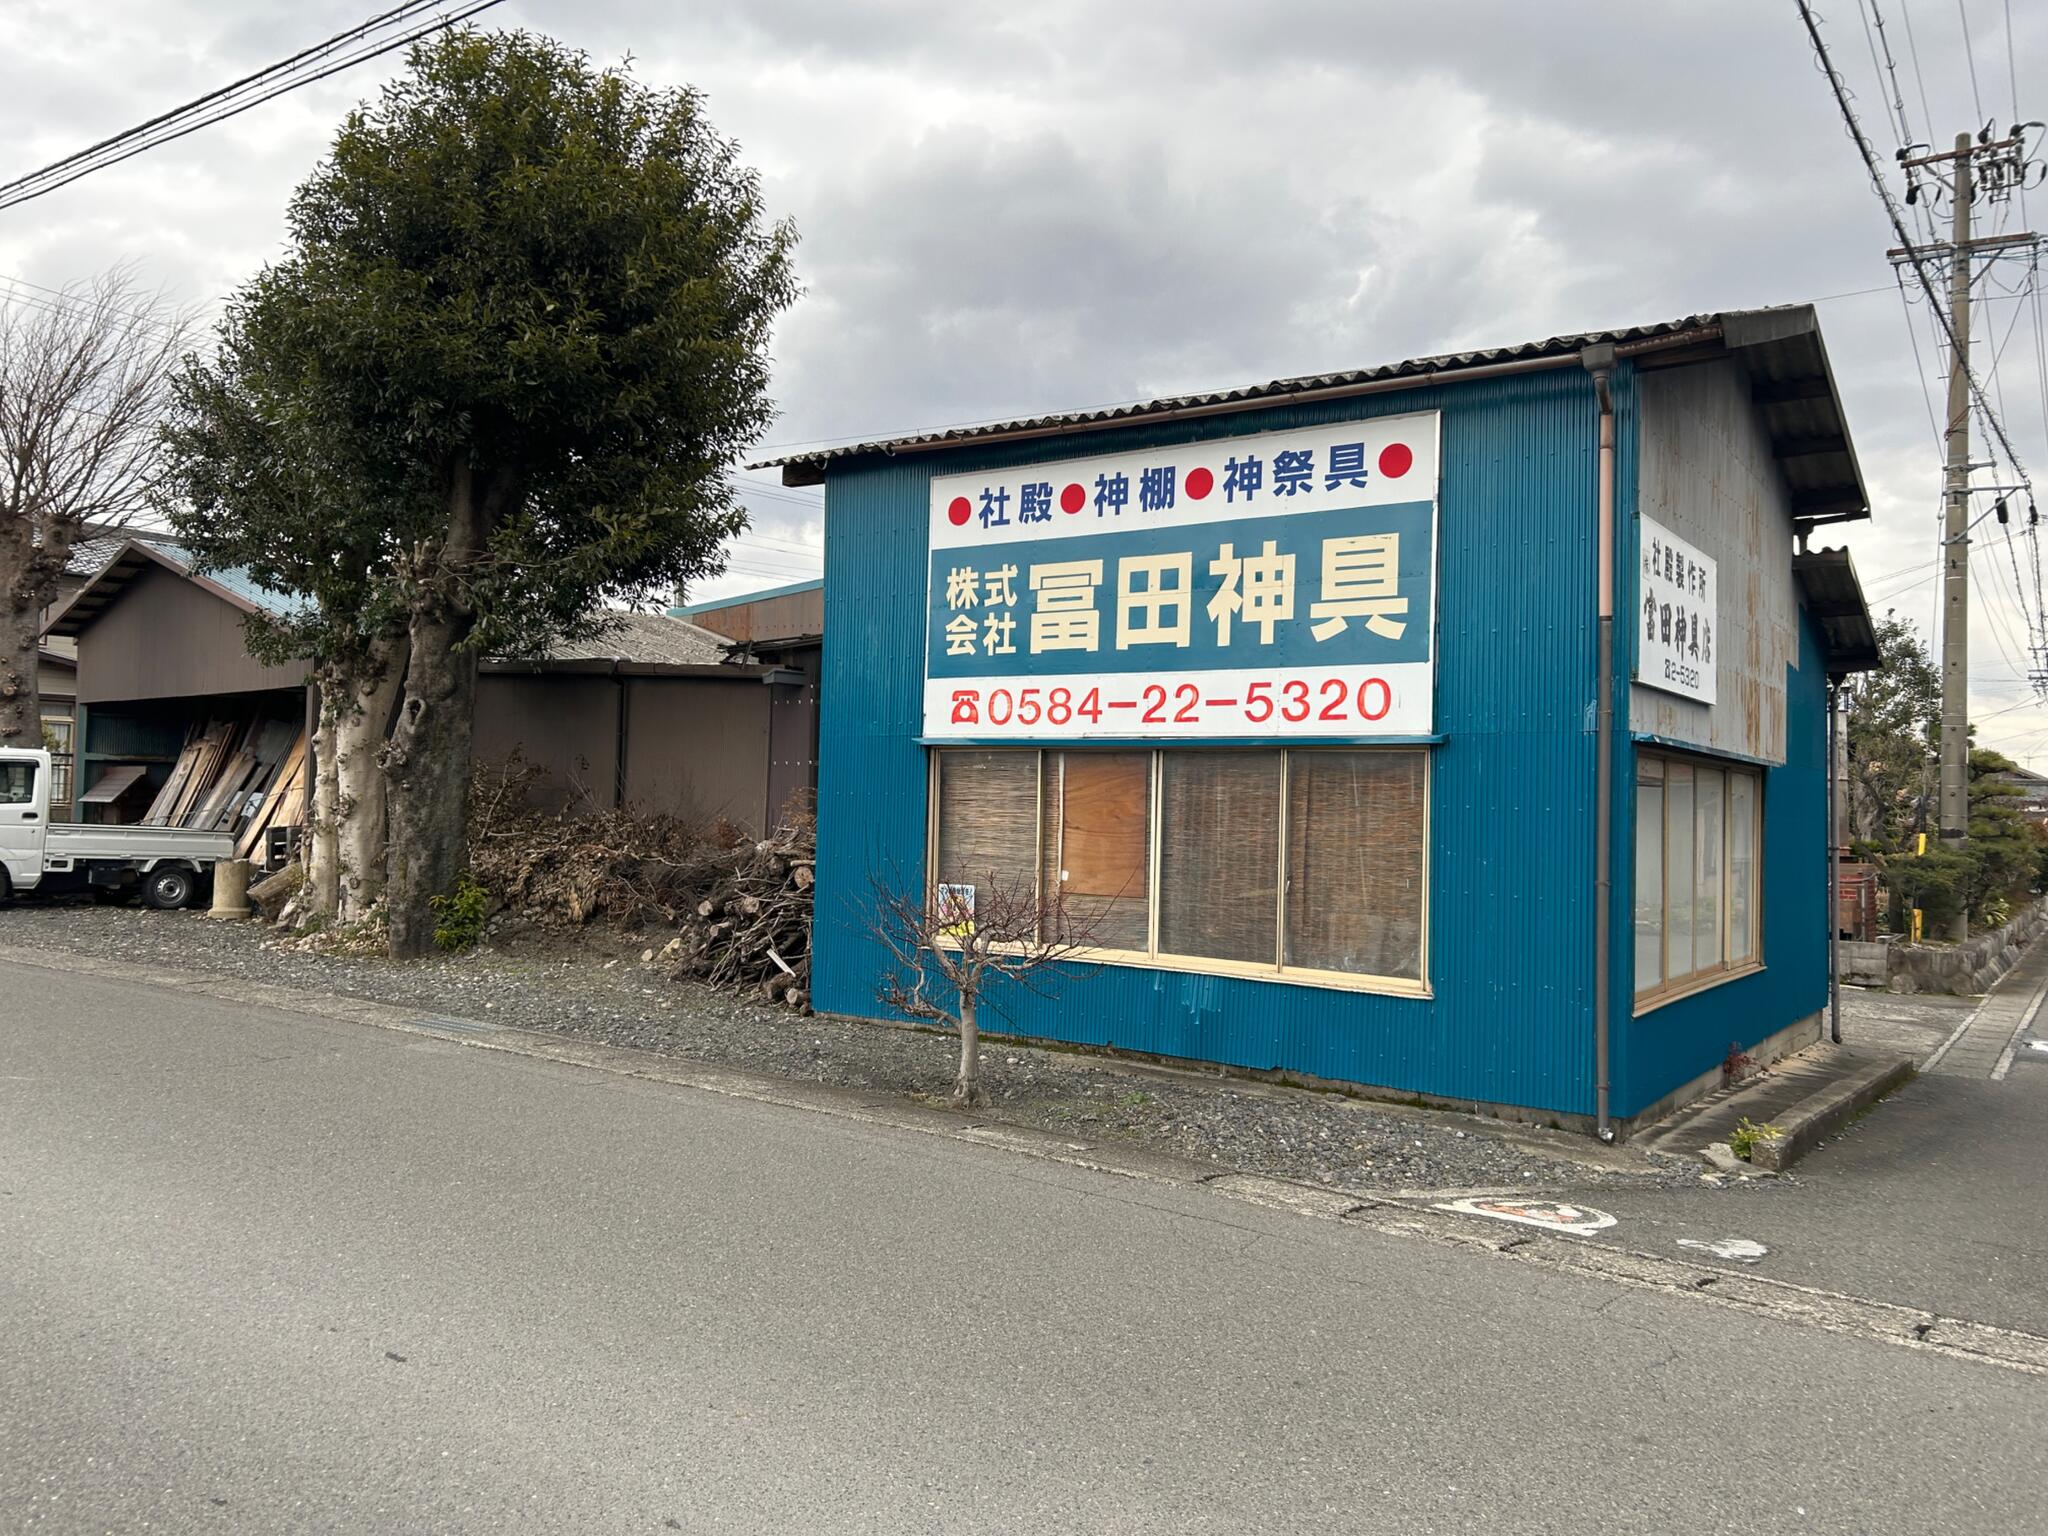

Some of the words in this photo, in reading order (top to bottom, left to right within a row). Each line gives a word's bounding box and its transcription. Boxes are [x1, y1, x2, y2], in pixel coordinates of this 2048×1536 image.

[979, 482, 1055, 528] 社殿
[1093, 466, 1177, 518] 神棚
[1223, 442, 1368, 502] 神祭具
[945, 565, 1019, 611] 株式
[945, 612, 1018, 656] 会社
[988, 677, 1392, 726] 0584-22-5320
